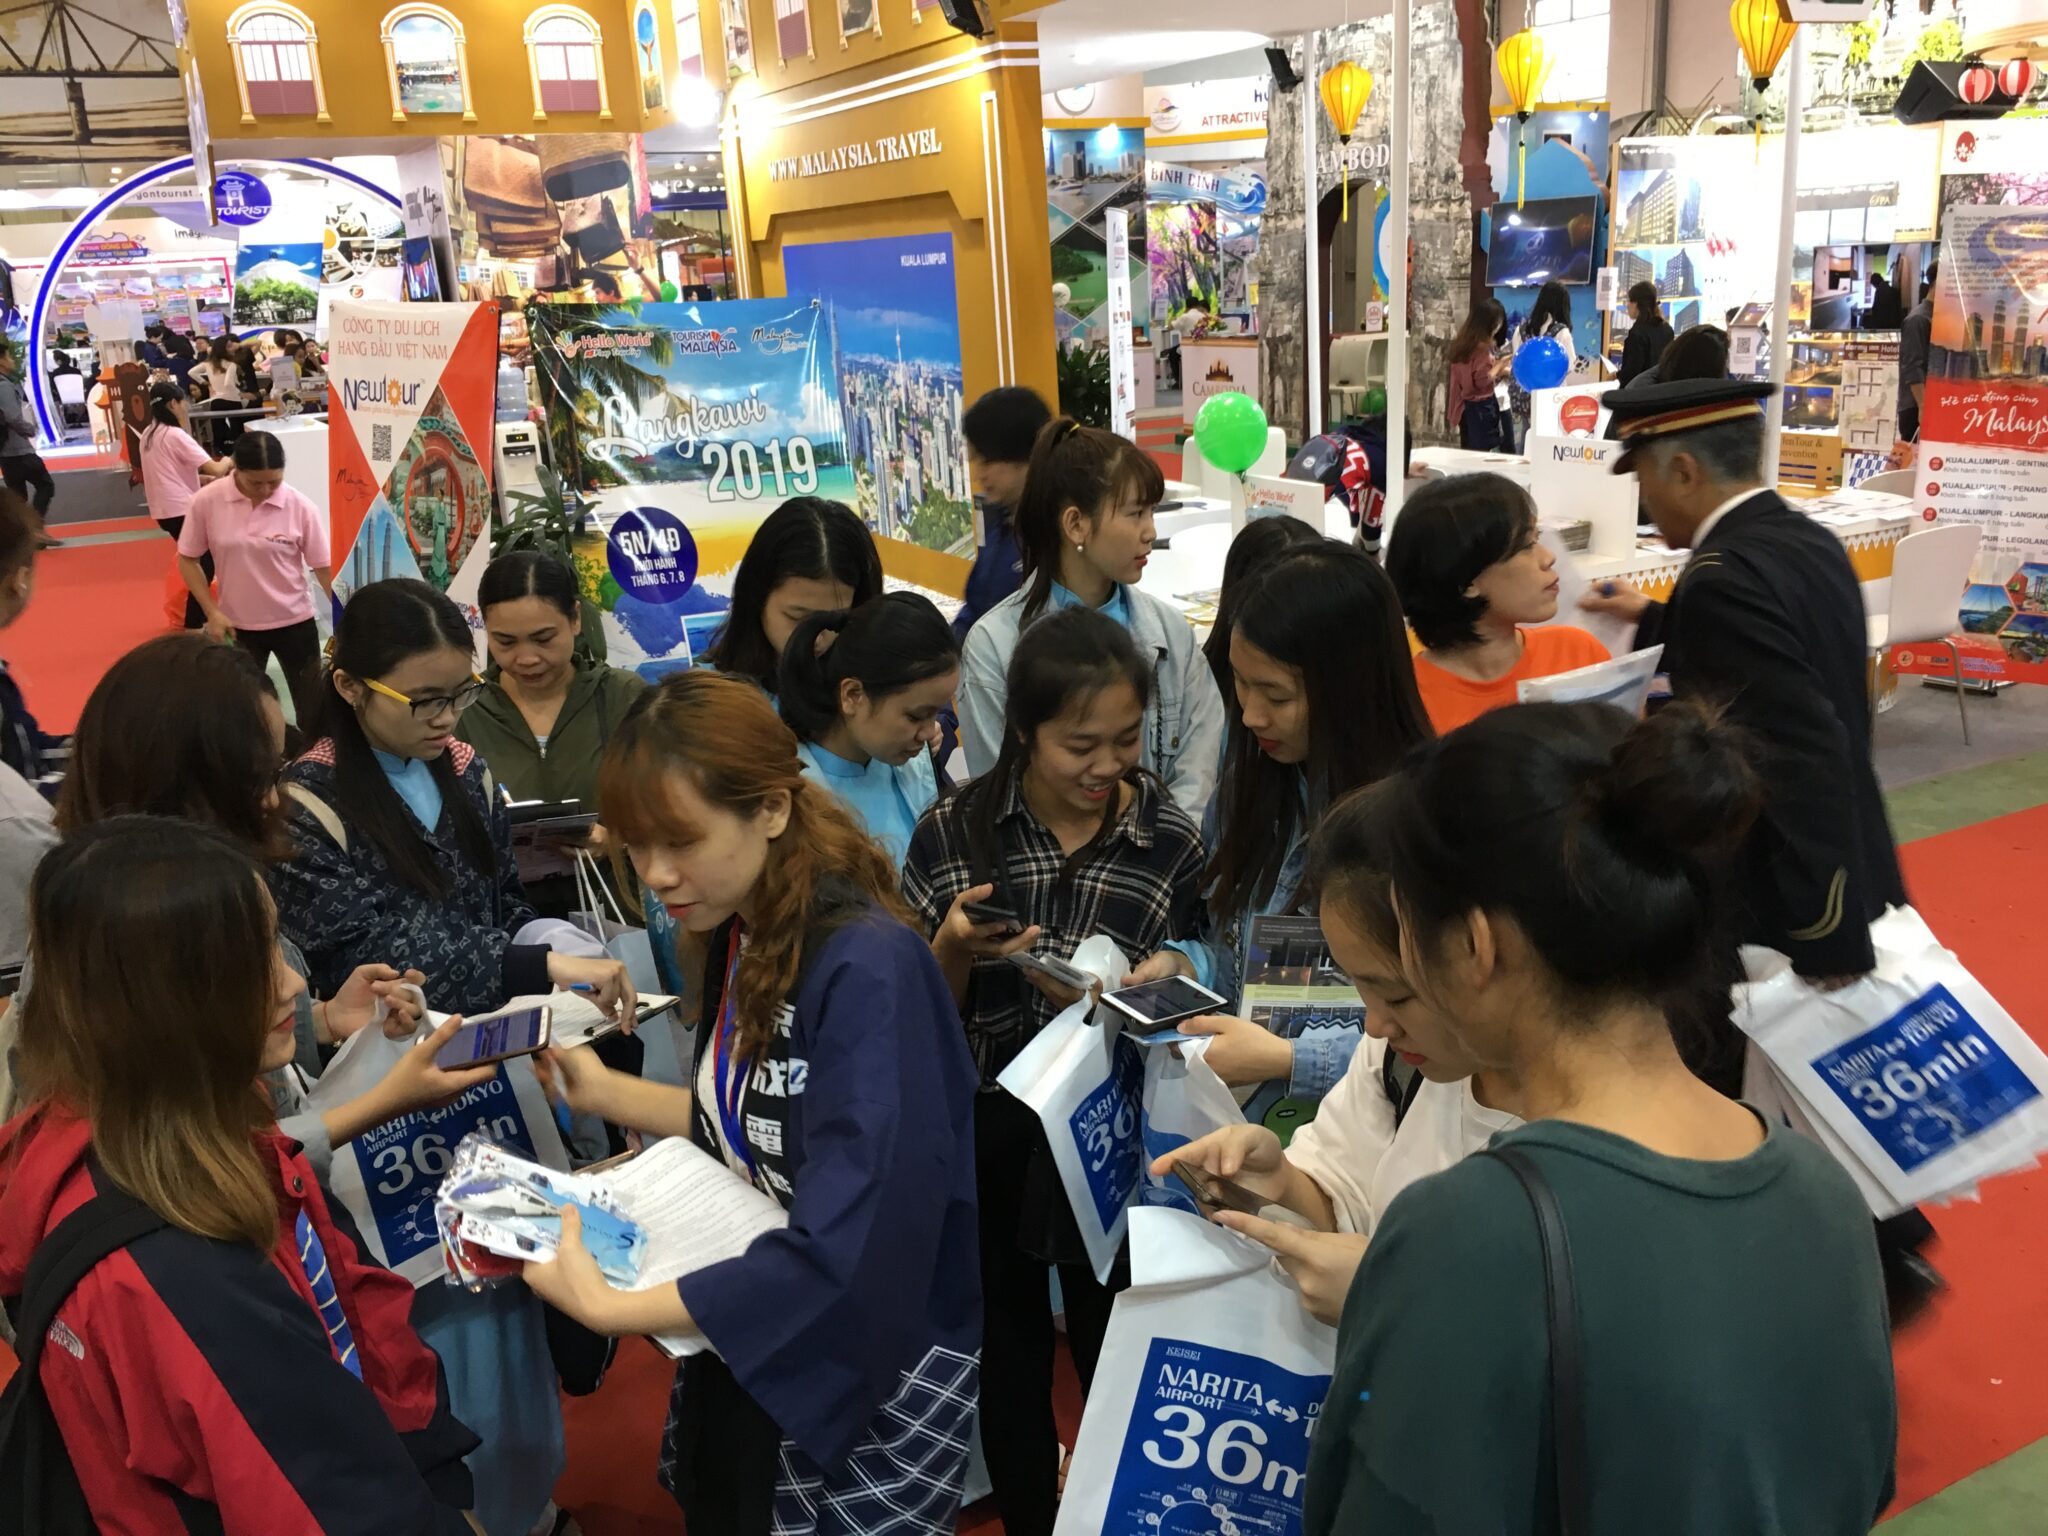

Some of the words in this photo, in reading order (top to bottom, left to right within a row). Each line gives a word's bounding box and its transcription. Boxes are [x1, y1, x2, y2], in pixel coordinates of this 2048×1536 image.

[768, 127, 942, 181] WWW.MALAYSIA.TRAVEL
[216, 205, 270, 217] TOURIST
[901, 254, 921, 267] KUALA
[922, 252, 947, 265] LUMPUR
[343, 316, 373, 335] CÔNG
[377, 319, 390, 335] TY
[394, 320, 410, 336] DU
[581, 334, 613, 349] Hello
[616, 331, 652, 347] World
[671, 330, 714, 342] TOURISM
[422, 343, 448, 360] NAM
[680, 342, 738, 357] MALAYSIA
[586, 386, 767, 462] Langkawi
[702, 435, 819, 503] 2019
[1945, 456, 2010, 467] KUALALUMPUR
[1939, 507, 2003, 517] KUALALUMPUR
[678, 570, 687, 582] 8
[366, 1127, 409, 1156] AIRPORT
[1166, 1346, 1201, 1360] KEISEI
[1158, 1363, 1264, 1407] NARITA
[1154, 1385, 1226, 1411] AIRPORT
